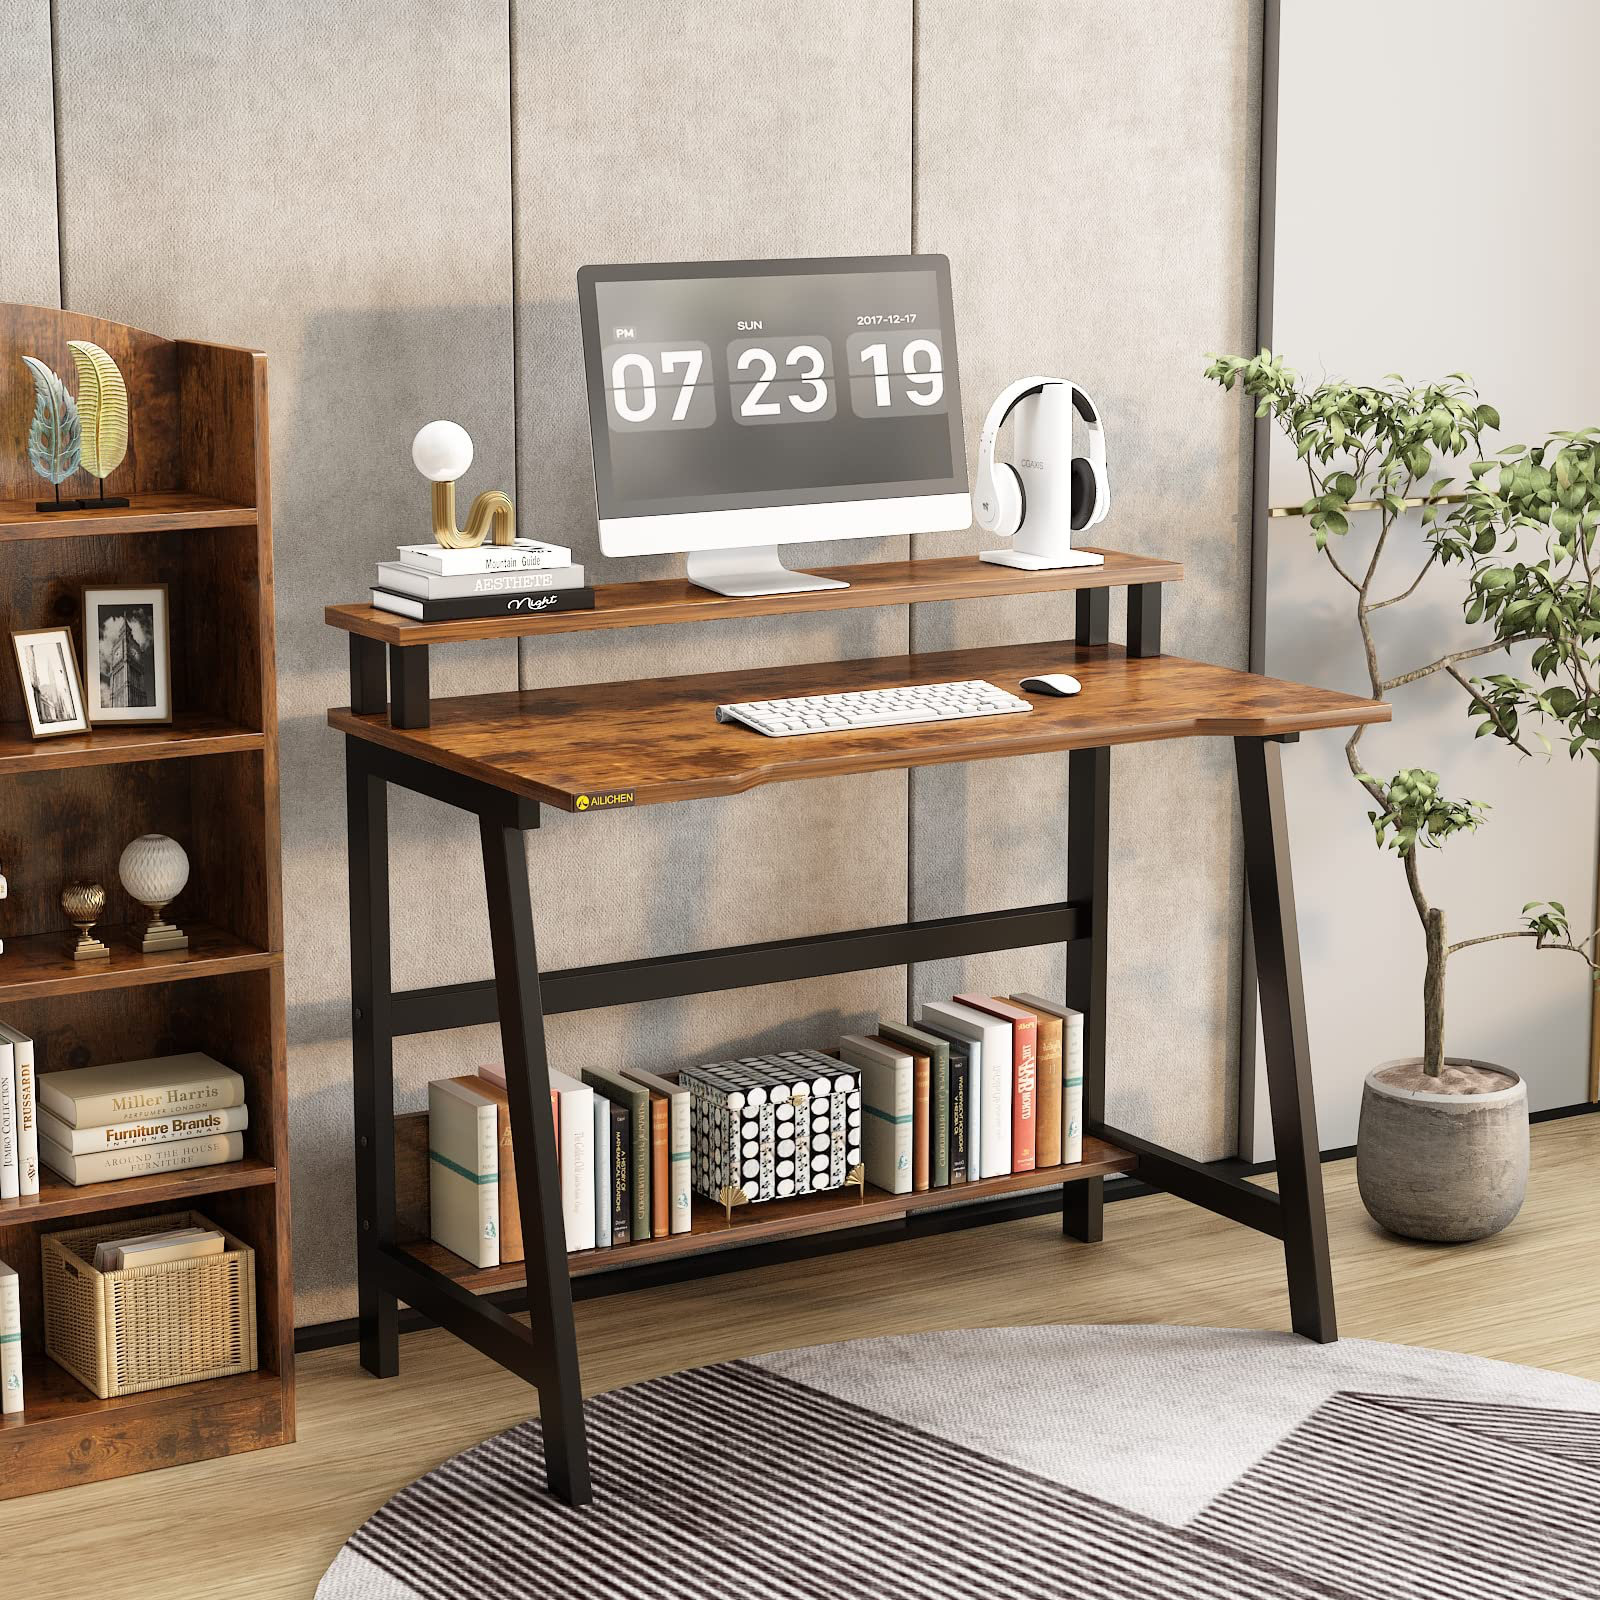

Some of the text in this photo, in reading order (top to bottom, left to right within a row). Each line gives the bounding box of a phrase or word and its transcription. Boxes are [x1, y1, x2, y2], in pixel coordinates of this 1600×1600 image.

[737, 320, 763, 331] SUN
[856, 313, 917, 326] 2017-12-17
[616, 328, 634, 338] PM
[611, 339, 944, 423] 07 23 19
[486, 556, 541, 569] Mountain Guide
[473, 574, 553, 592] AESTHETE
[507, 594, 558, 610] Night
[590, 792, 634, 806] AILICHEN
[21, 1064, 32, 1131] TRUSSARDI
[111, 1085, 219, 1112] Miller Harris
[123, 1103, 208, 1119] PERFUMER LONDON
[106, 1114, 221, 1142] Furniture Brands
[106, 1127, 221, 1148] INTERNATIONAL
[3, 1137, 13, 1167] JUMBO
[104, 1143, 221, 1168] AROUND THE HOUSE
[131, 1156, 194, 1172] FURNITURE
